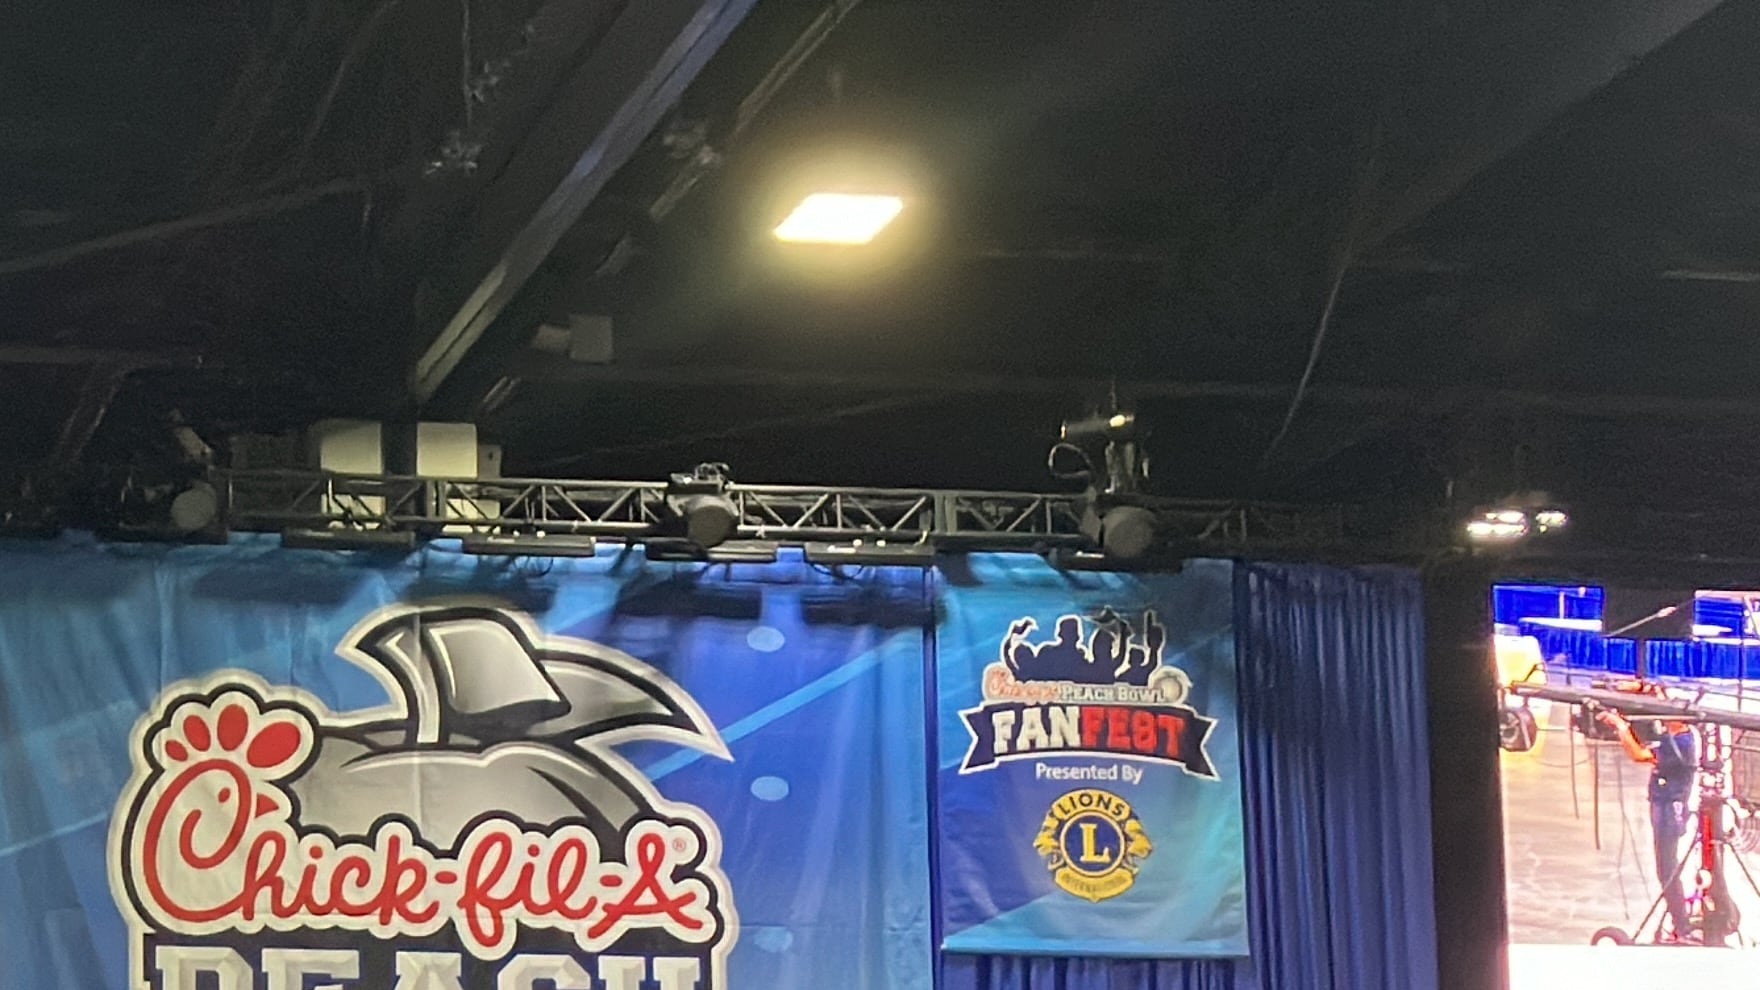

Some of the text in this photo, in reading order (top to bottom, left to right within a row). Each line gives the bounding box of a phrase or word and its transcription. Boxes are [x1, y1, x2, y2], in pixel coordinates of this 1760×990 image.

[992, 706, 1185, 758] FANFEST
[1036, 763, 1143, 785] Presented By
[1058, 793, 1126, 816] LIONS
[1079, 823, 1111, 863] L
